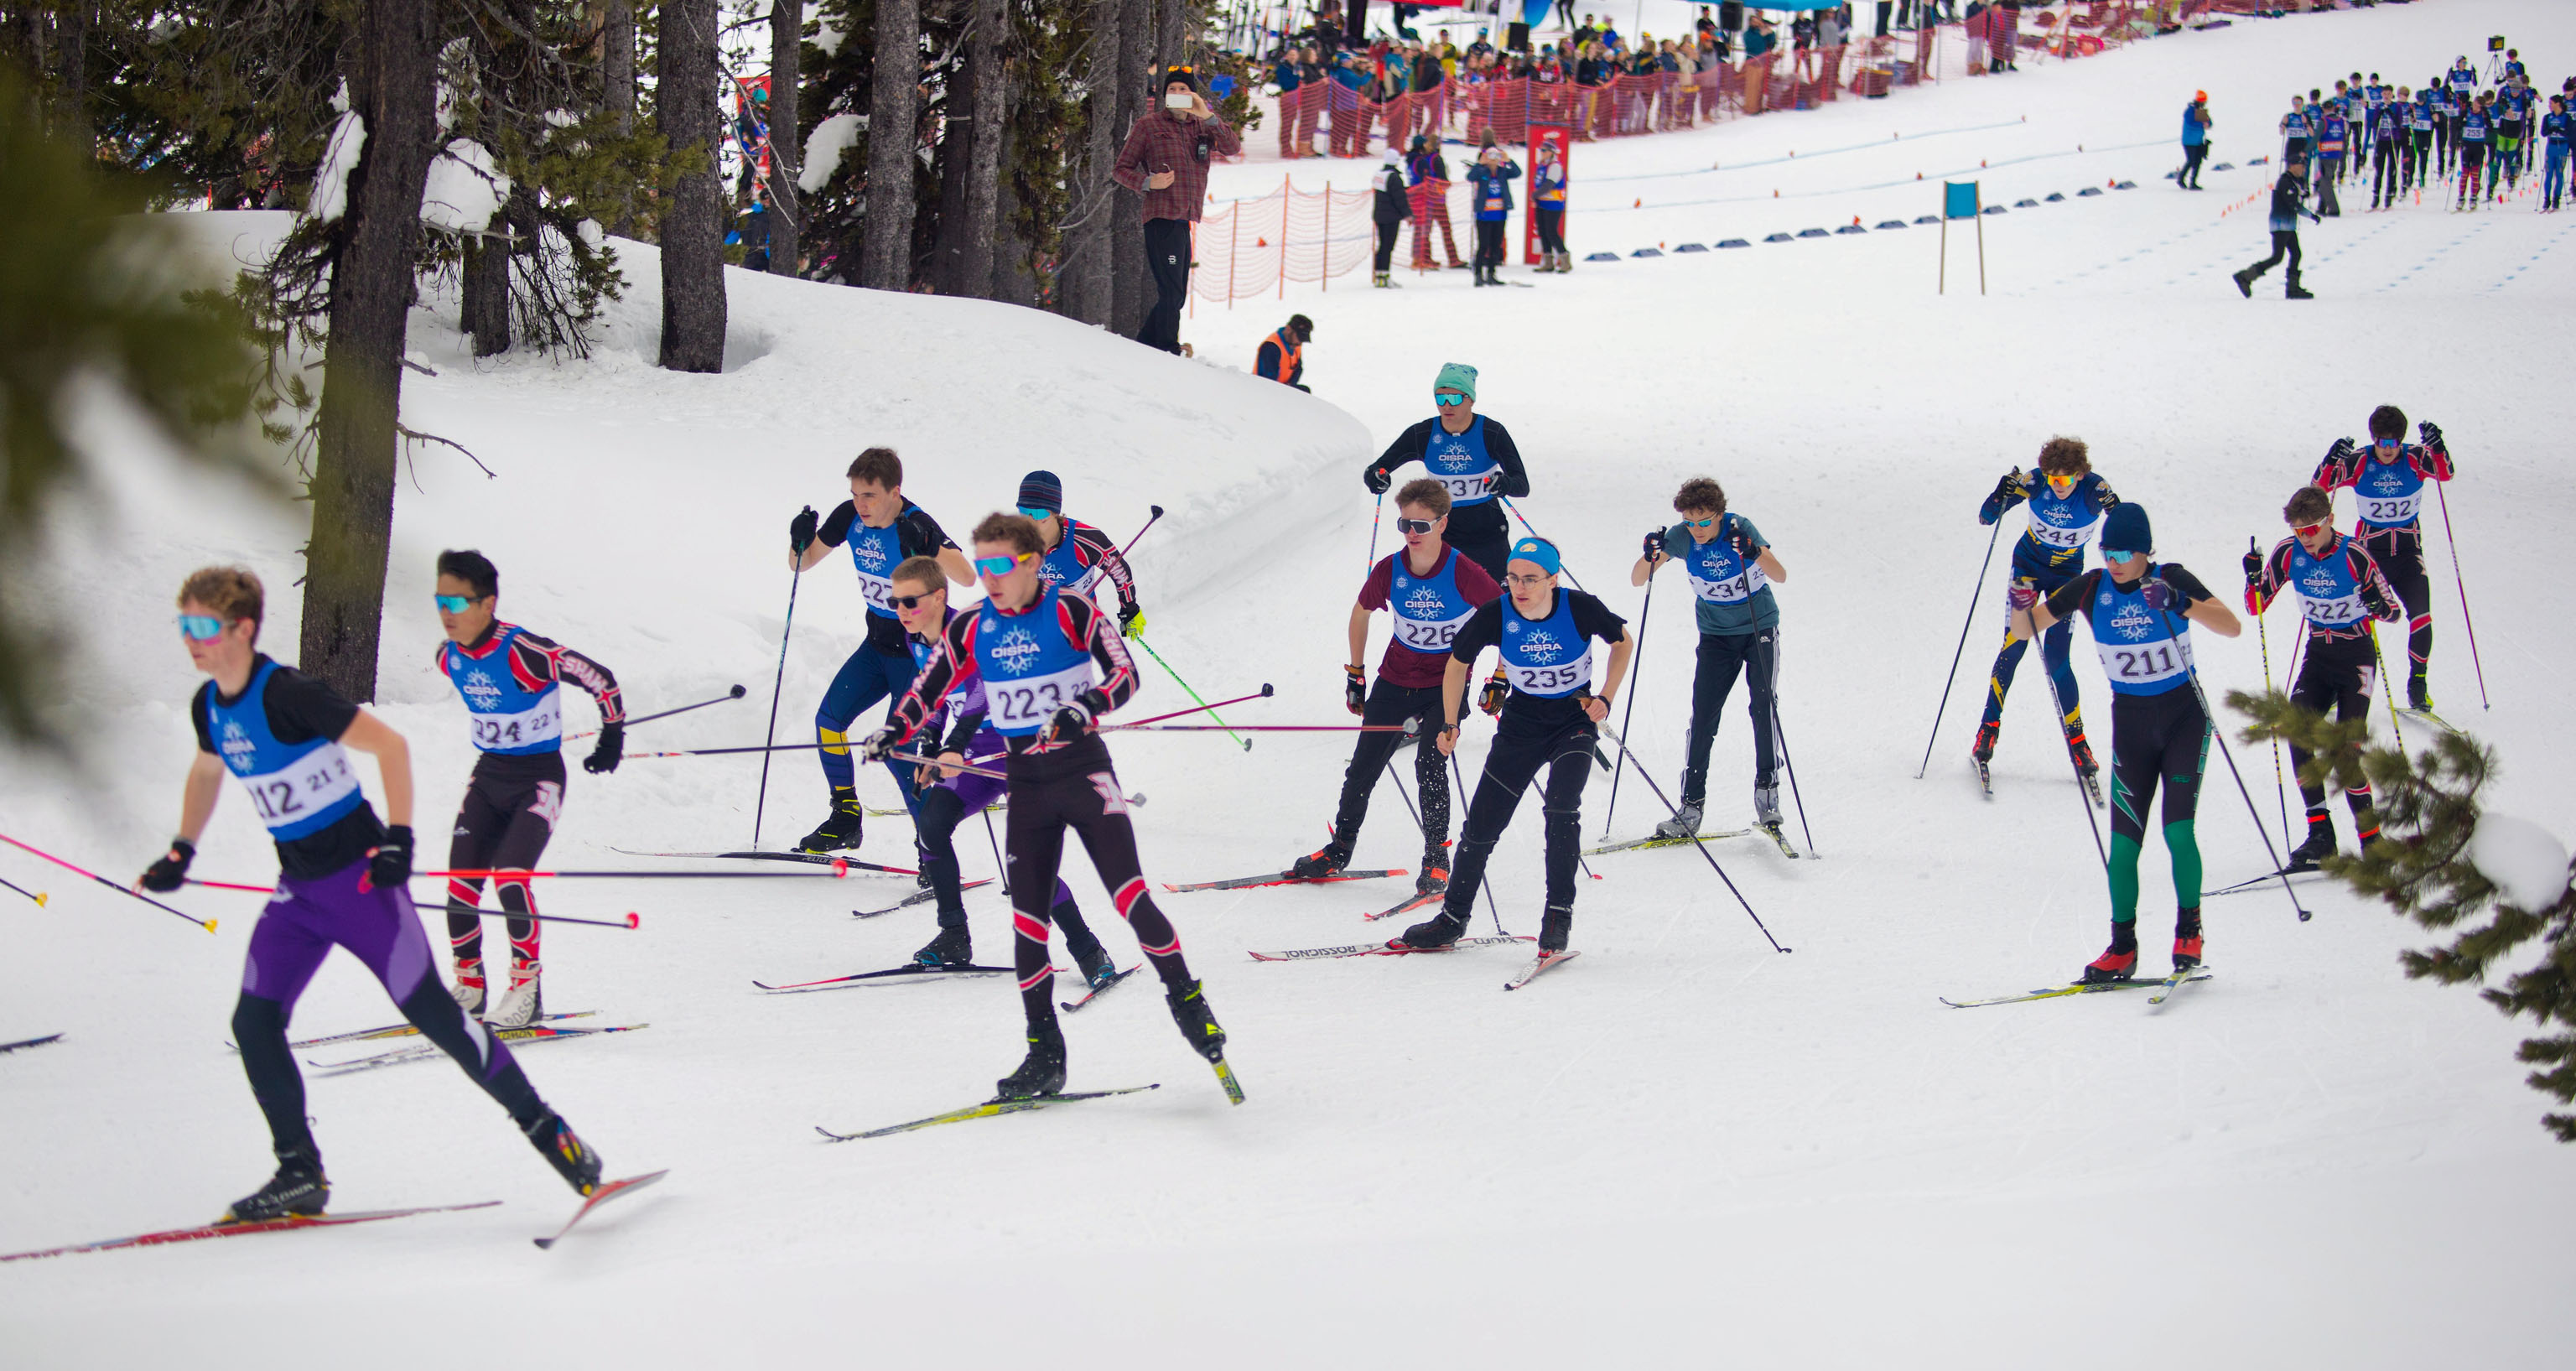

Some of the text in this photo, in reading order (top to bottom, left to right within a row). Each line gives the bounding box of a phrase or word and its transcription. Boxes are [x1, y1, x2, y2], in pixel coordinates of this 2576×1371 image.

[2043, 509, 2074, 520] OISRA
[2370, 500, 2411, 518] 232
[2036, 522, 2078, 545] 244
[855, 547, 887, 562] OISRA
[1036, 572, 1066, 580] SRA
[2303, 578, 2338, 587] OISRA
[858, 576, 893, 604] 22
[1405, 600, 1445, 609] OISRA
[2305, 600, 2350, 620] 222
[2111, 616, 2153, 627] OISRA
[1406, 623, 1457, 646] 226
[991, 642, 1041, 659] OISRA
[1519, 643, 1563, 652] OISRA
[2115, 647, 2175, 678] 211
[1521, 666, 1577, 688] 235
[463, 684, 502, 696] OISRA
[998, 683, 1062, 720] 223
[473, 718, 522, 744] 224
[1281, 945, 1357, 958] ROSSIGNOL
